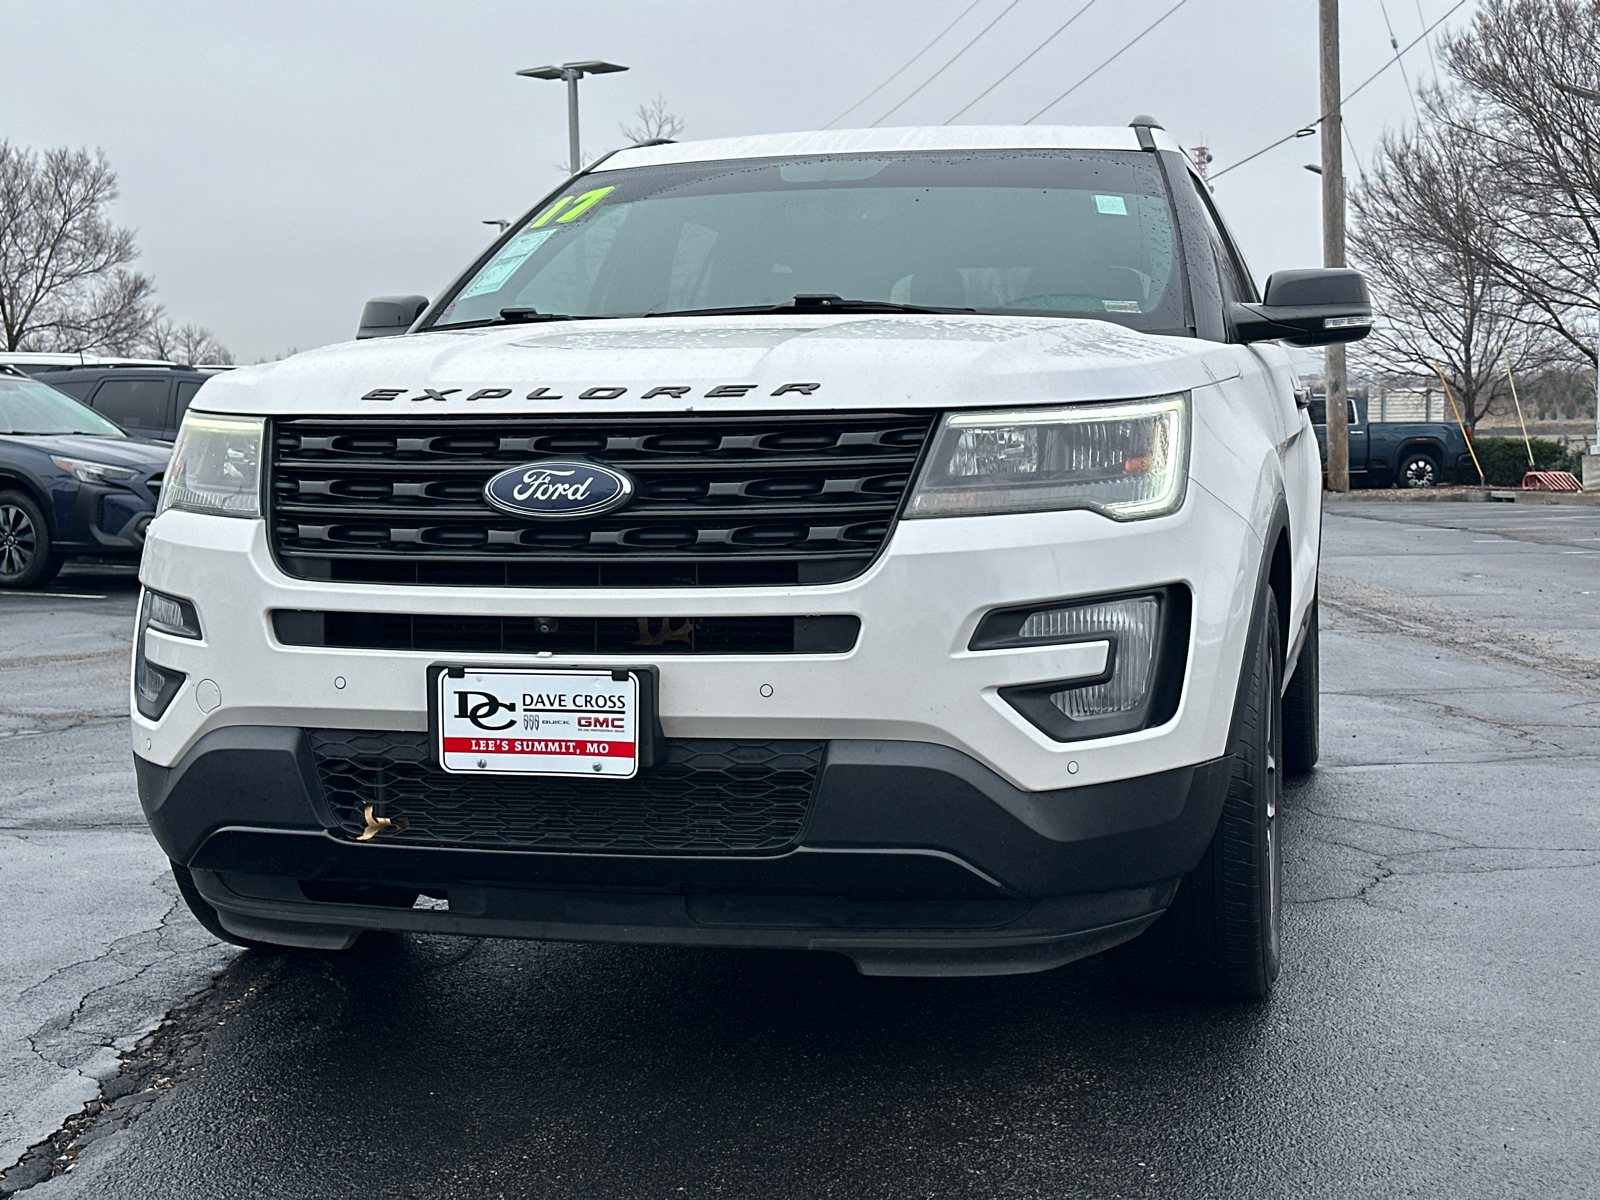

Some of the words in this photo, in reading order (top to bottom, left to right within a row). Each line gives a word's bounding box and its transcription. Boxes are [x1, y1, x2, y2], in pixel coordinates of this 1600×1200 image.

[530, 185, 615, 229] 17
[361, 382, 821, 402] EXPLORER
[514, 469, 593, 502] Ford
[453, 691, 517, 731] DC
[522, 693, 567, 708] DAVE
[572, 694, 626, 709] CROSS
[577, 717, 625, 729] GMC
[471, 740, 509, 751] LEE'S
[514, 741, 580, 755] SUMMIT,
[586, 743, 609, 754] MO
